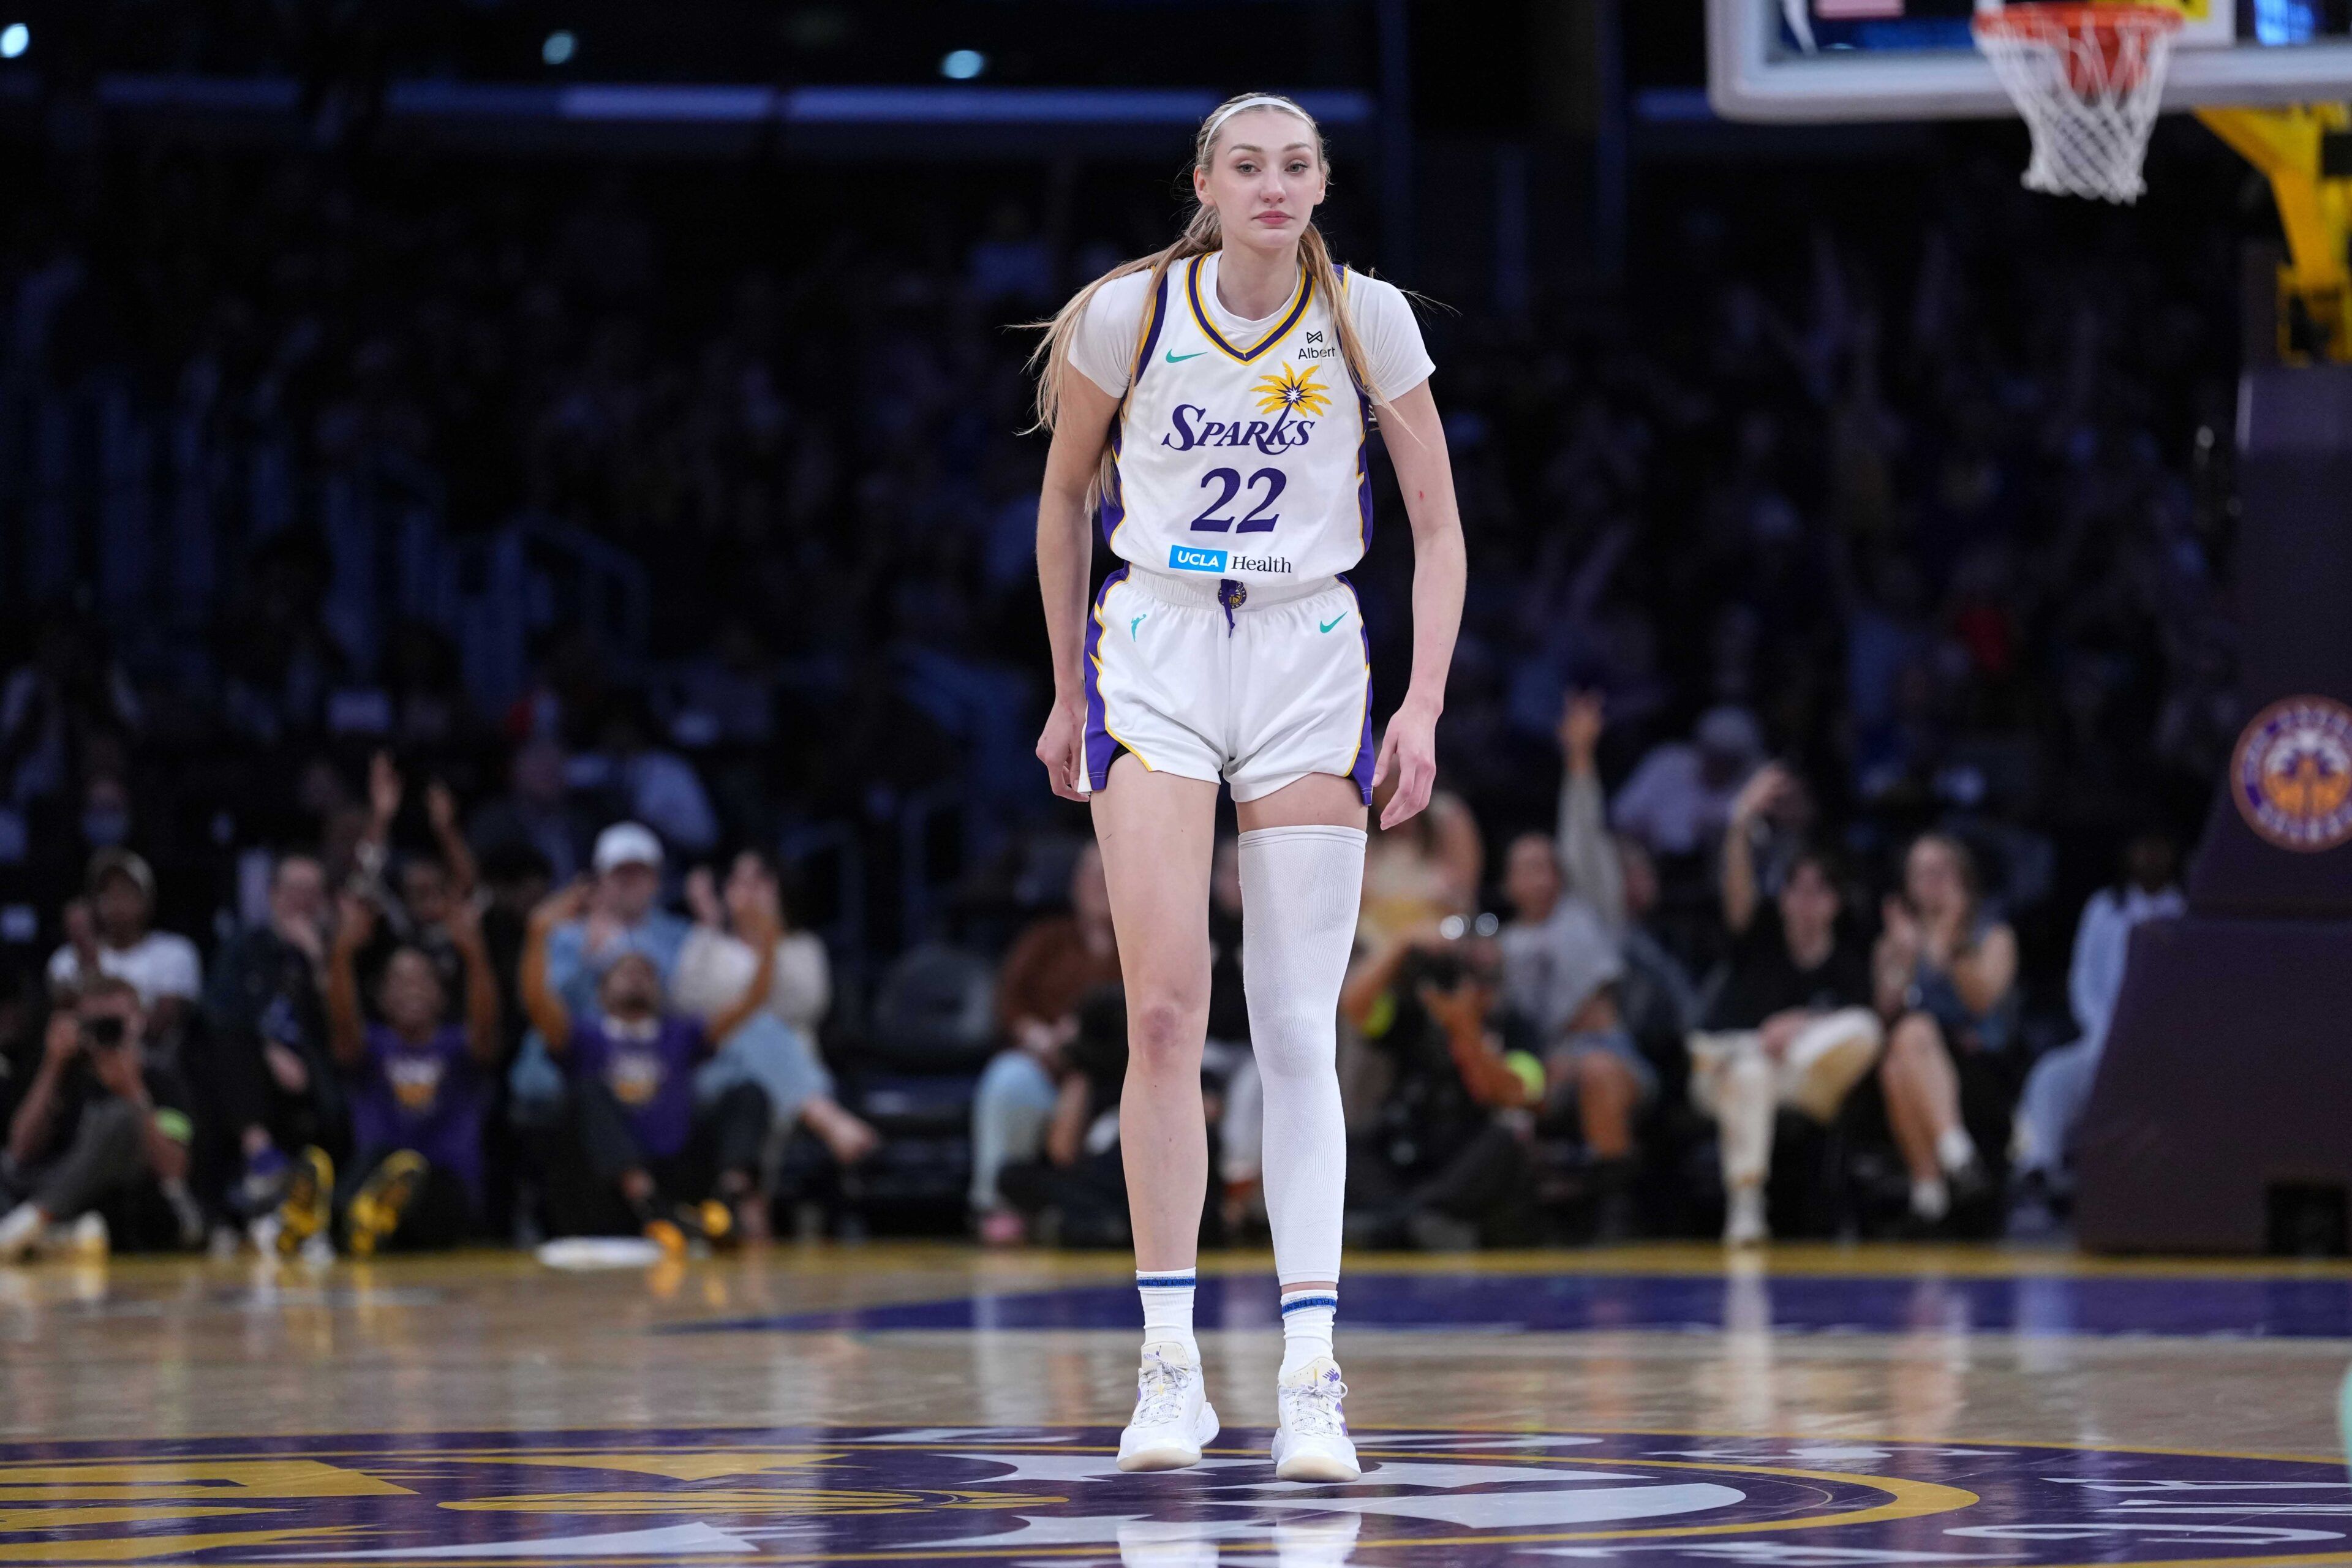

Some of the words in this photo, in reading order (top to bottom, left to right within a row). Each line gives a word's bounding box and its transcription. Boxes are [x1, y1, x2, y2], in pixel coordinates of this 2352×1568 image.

[1298, 347, 1335, 360] Albert
[1189, 467, 1287, 533] 22
[1177, 550, 1219, 567] UCLA
[1231, 556, 1292, 573] Health
